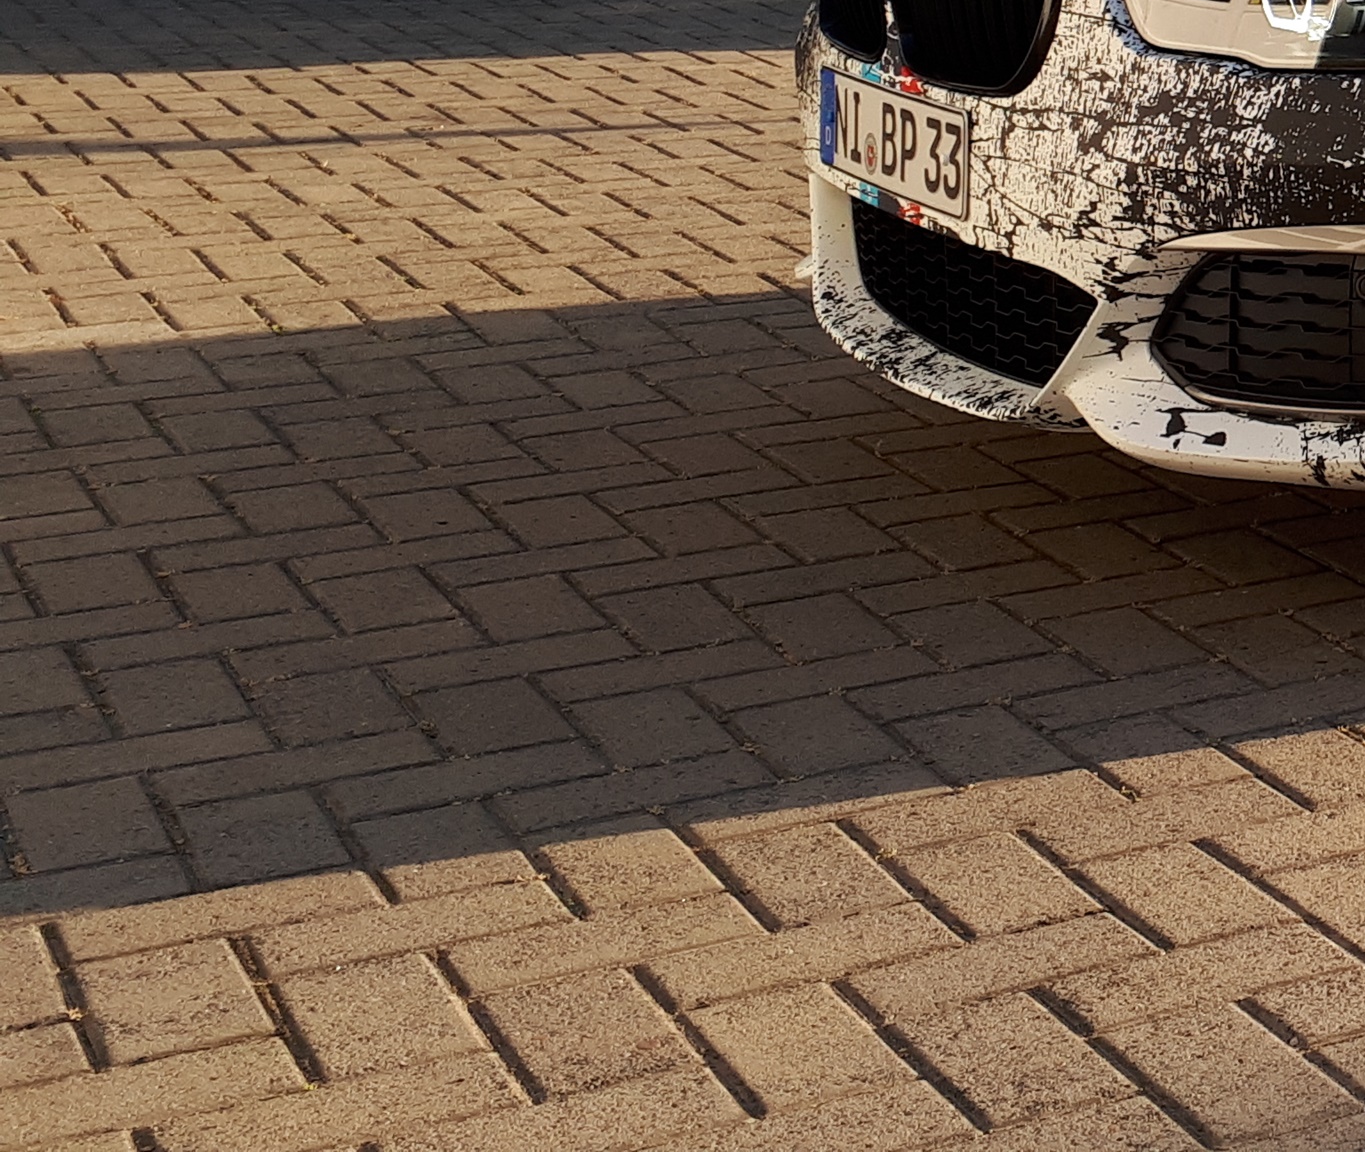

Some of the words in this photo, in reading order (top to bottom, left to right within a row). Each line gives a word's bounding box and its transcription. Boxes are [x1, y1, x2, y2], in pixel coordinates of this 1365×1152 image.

[834, 84, 861, 165] NI
[881, 102, 917, 183] BP
[924, 116, 962, 200] 33
